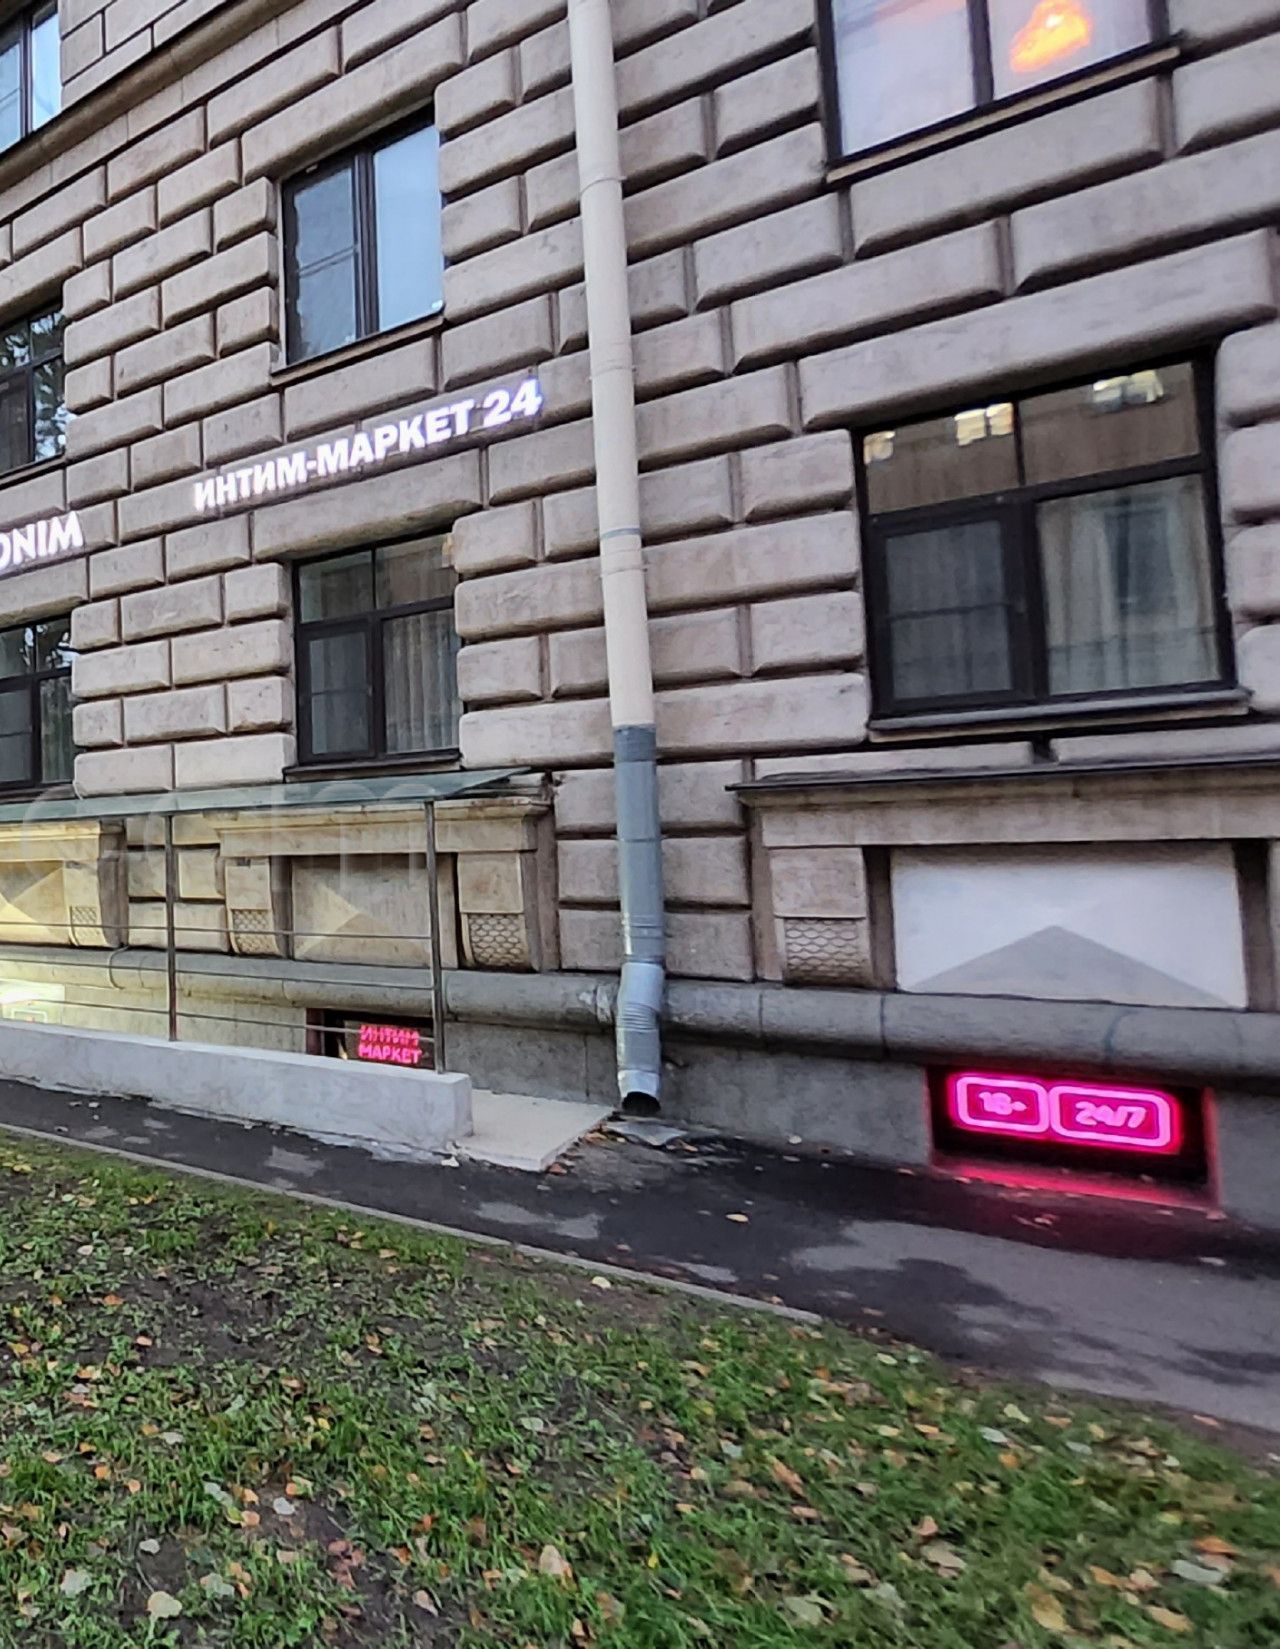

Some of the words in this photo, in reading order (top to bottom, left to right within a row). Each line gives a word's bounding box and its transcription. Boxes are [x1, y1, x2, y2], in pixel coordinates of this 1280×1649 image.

[194, 399, 475, 511] ИНТИМ-МАРКЕТ
[482, 379, 543, 429] 24
[360, 1024, 419, 1046] ИНТИМ
[358, 1044, 422, 1064] МАРКЕТ
[1075, 1101, 1146, 1129] 24/7
